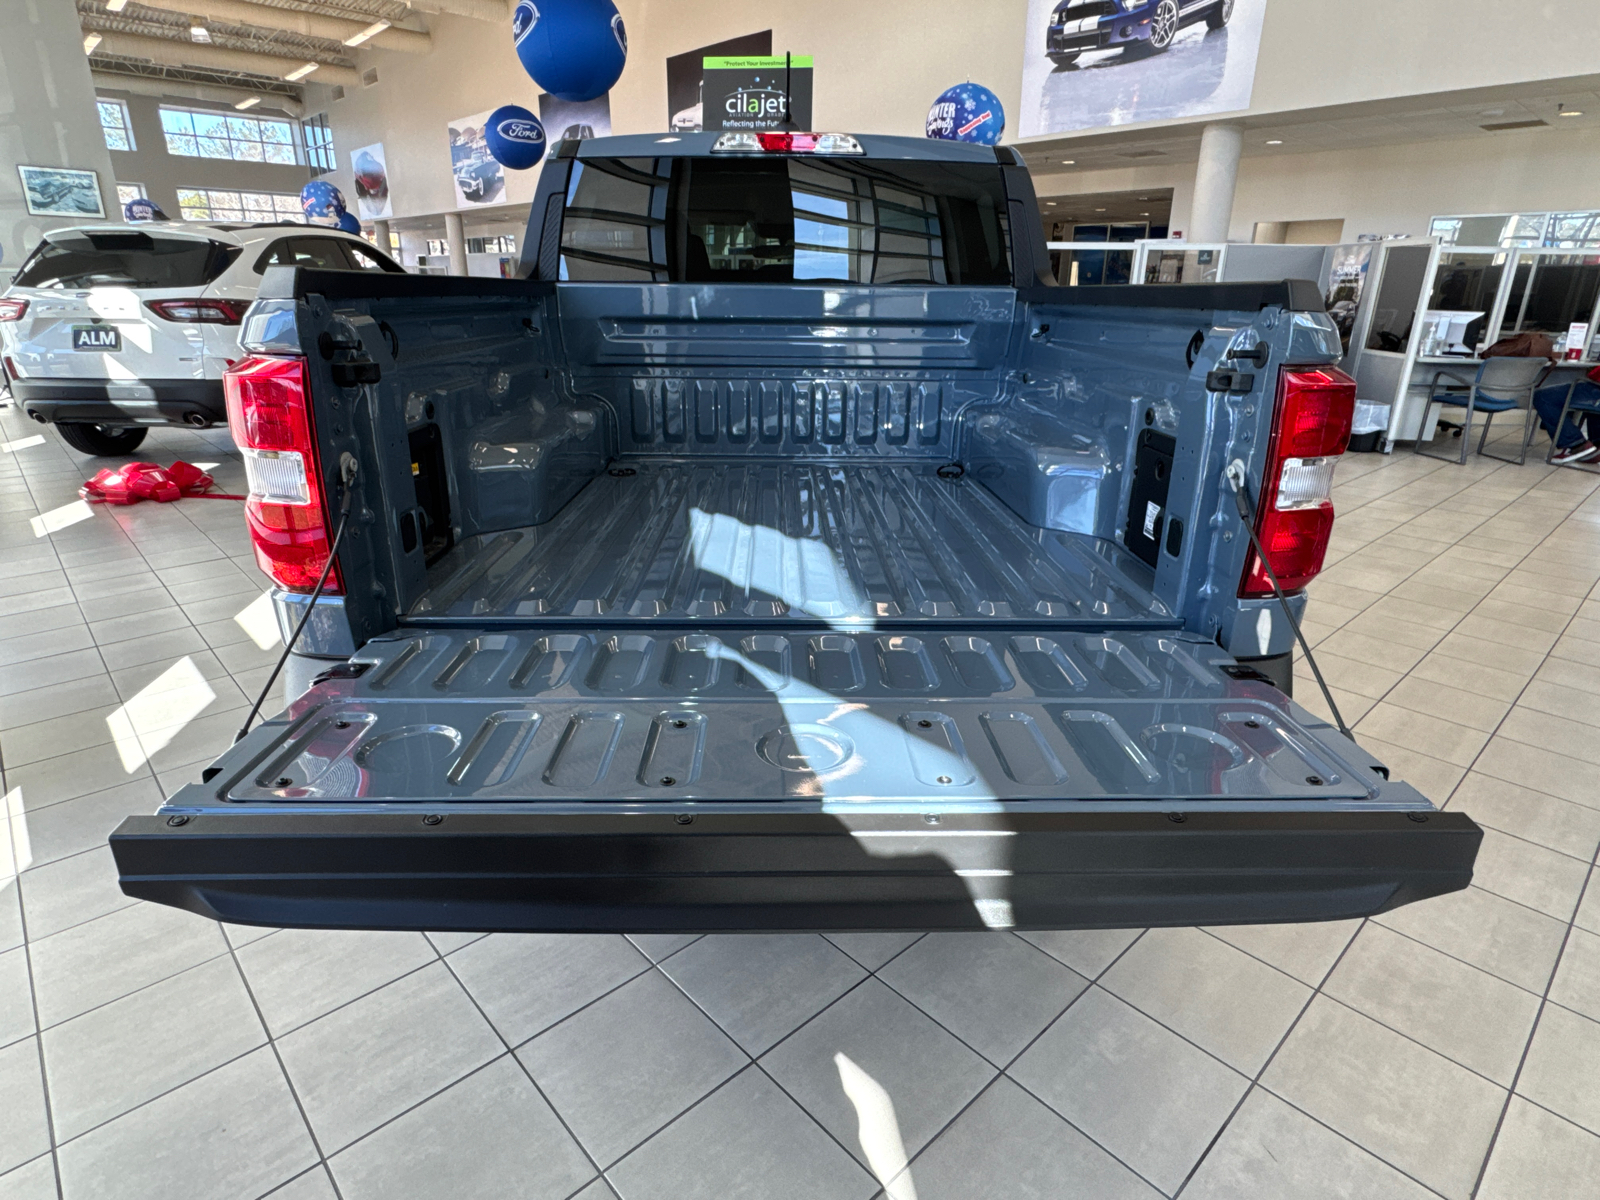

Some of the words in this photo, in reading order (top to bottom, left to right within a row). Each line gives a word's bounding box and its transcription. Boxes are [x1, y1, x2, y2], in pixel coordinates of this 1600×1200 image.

[725, 93, 786, 118] cilajet
[509, 123, 538, 140] Ford
[722, 119, 754, 129] Reflecting
[755, 119, 766, 128] the
[79, 331, 116, 346] ALM
